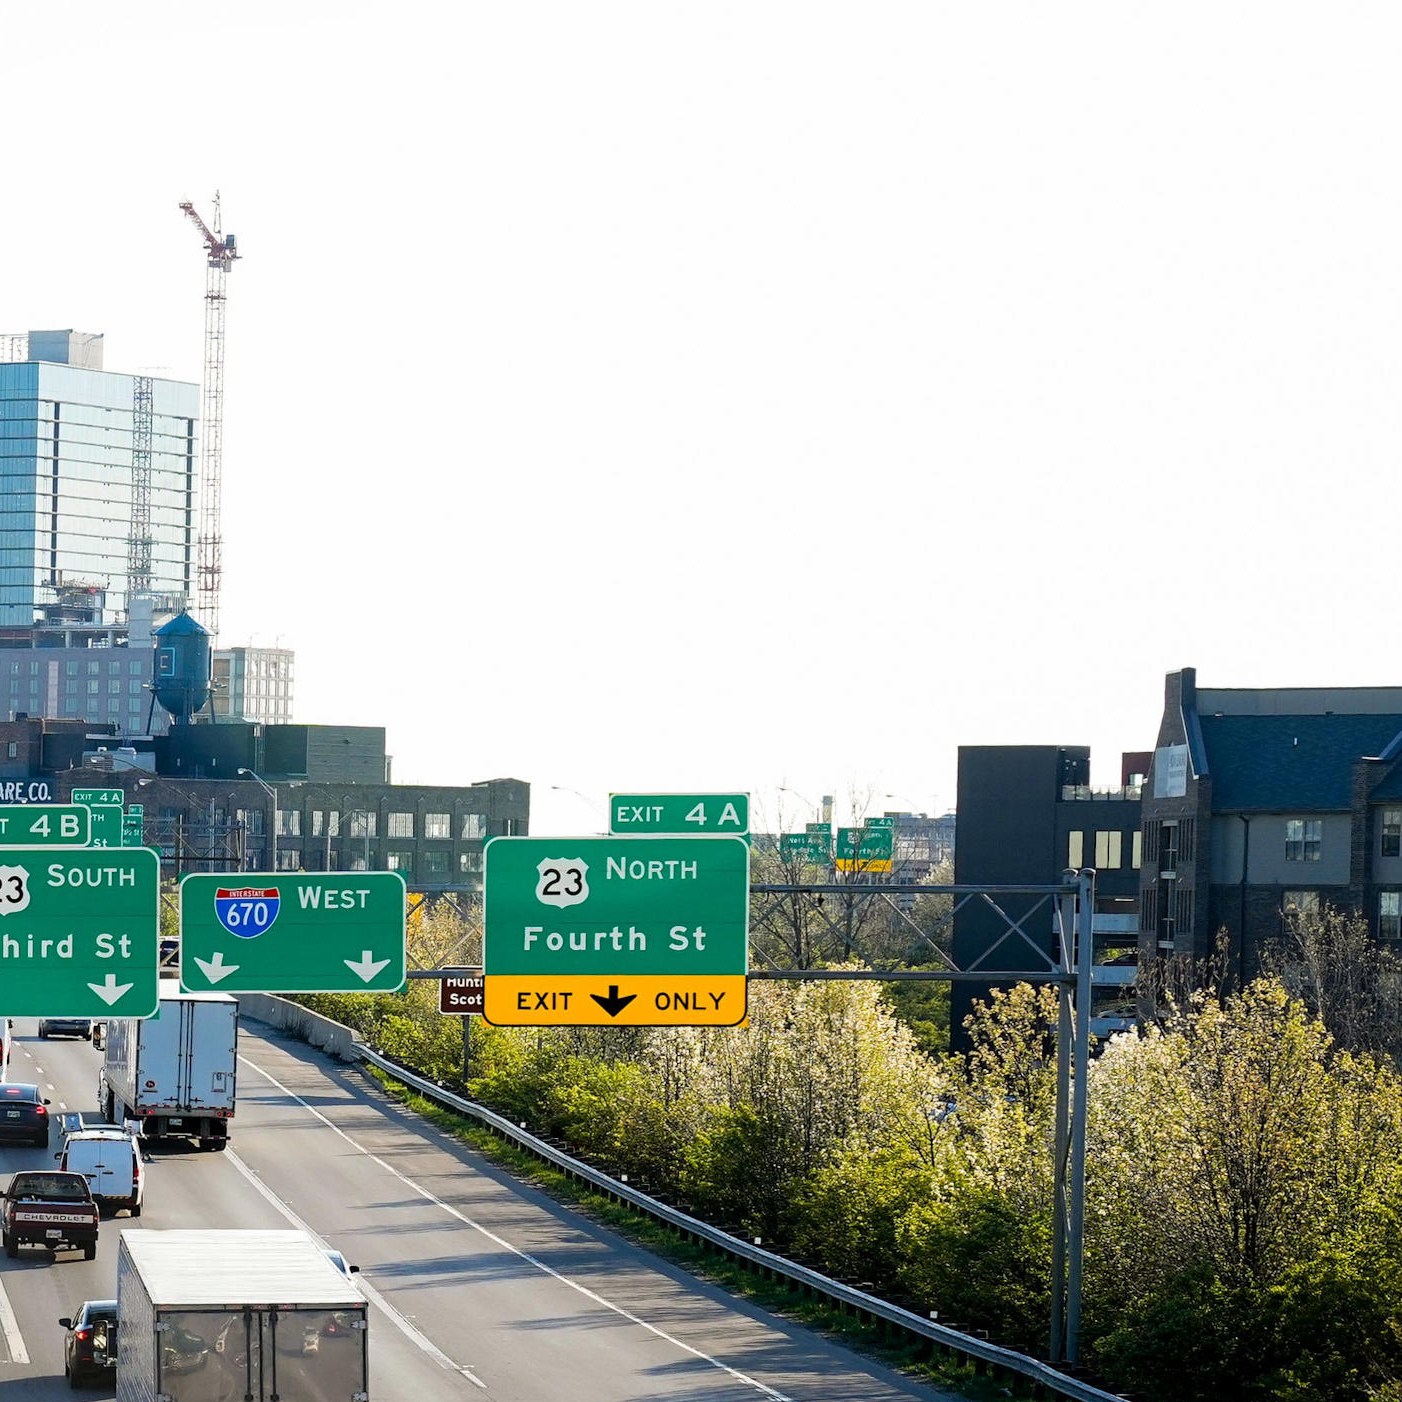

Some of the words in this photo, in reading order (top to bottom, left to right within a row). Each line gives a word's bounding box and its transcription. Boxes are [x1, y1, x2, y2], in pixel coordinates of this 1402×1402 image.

[29, 782, 52, 801] CO.
[74, 793, 92, 801] EXIT
[617, 806, 664, 822] EXIT
[93, 838, 108, 848] St
[47, 864, 135, 887] SOUTH
[542, 868, 583, 896] 23
[606, 856, 697, 881] NORTH
[229, 890, 265, 898] INTERSTATE
[227, 902, 268, 927] 670
[297, 885, 371, 909] WEST
[95, 933, 132, 959] St
[523, 926, 646, 951] Fourth
[669, 925, 706, 951] St
[517, 992, 573, 1010] EXIT
[655, 991, 726, 1011] ONLY
[23, 1213, 87, 1222] CHEVROLET
